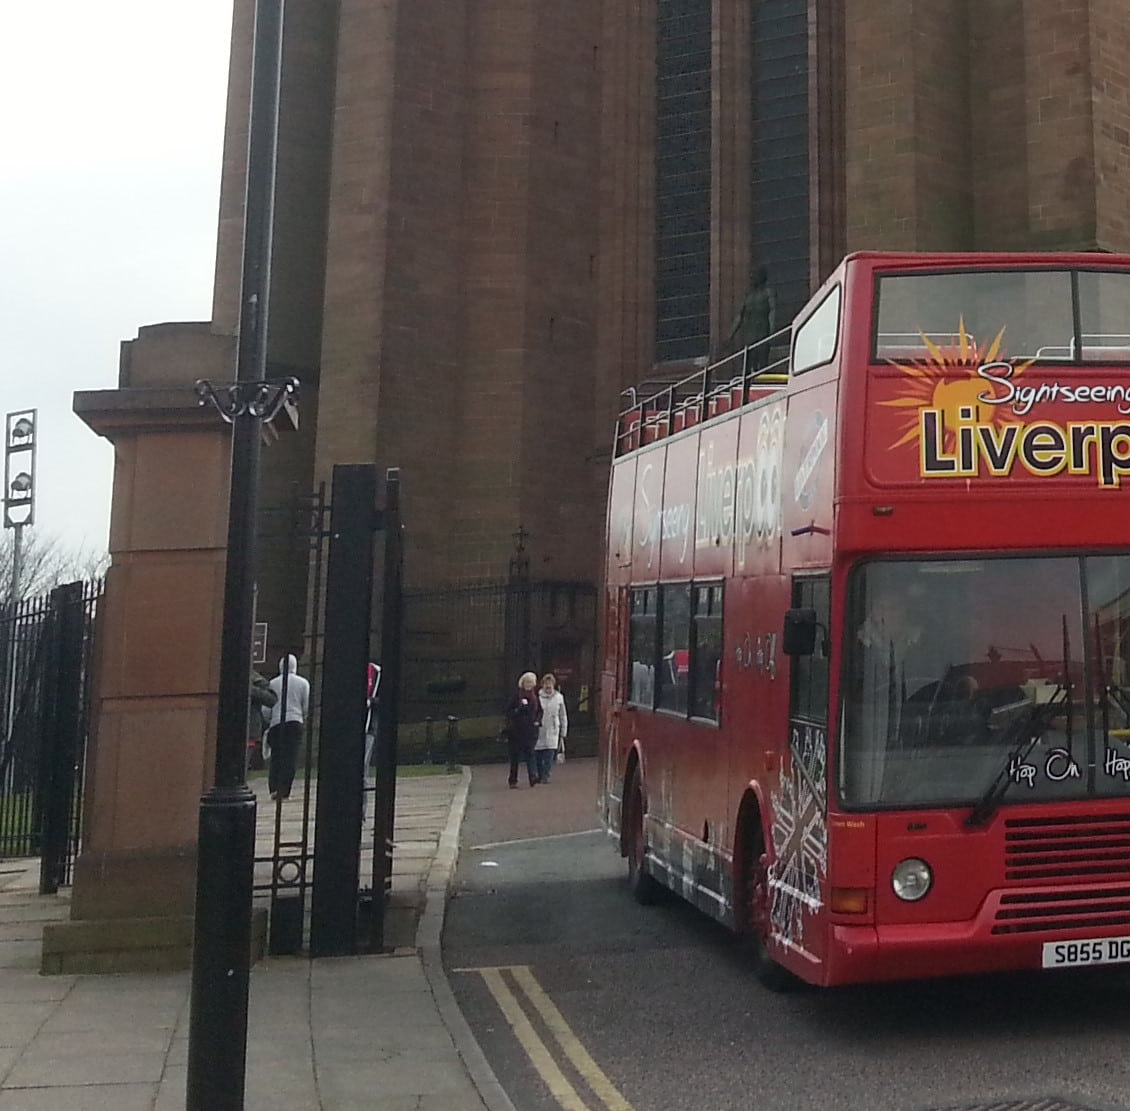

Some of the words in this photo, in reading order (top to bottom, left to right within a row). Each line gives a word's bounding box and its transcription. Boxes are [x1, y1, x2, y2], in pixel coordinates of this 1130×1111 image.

[1010, 756, 1036, 787] Hop
[1047, 749, 1080, 780] On
[1106, 748, 1130, 781] Hop
[1055, 942, 1103, 963] S855
